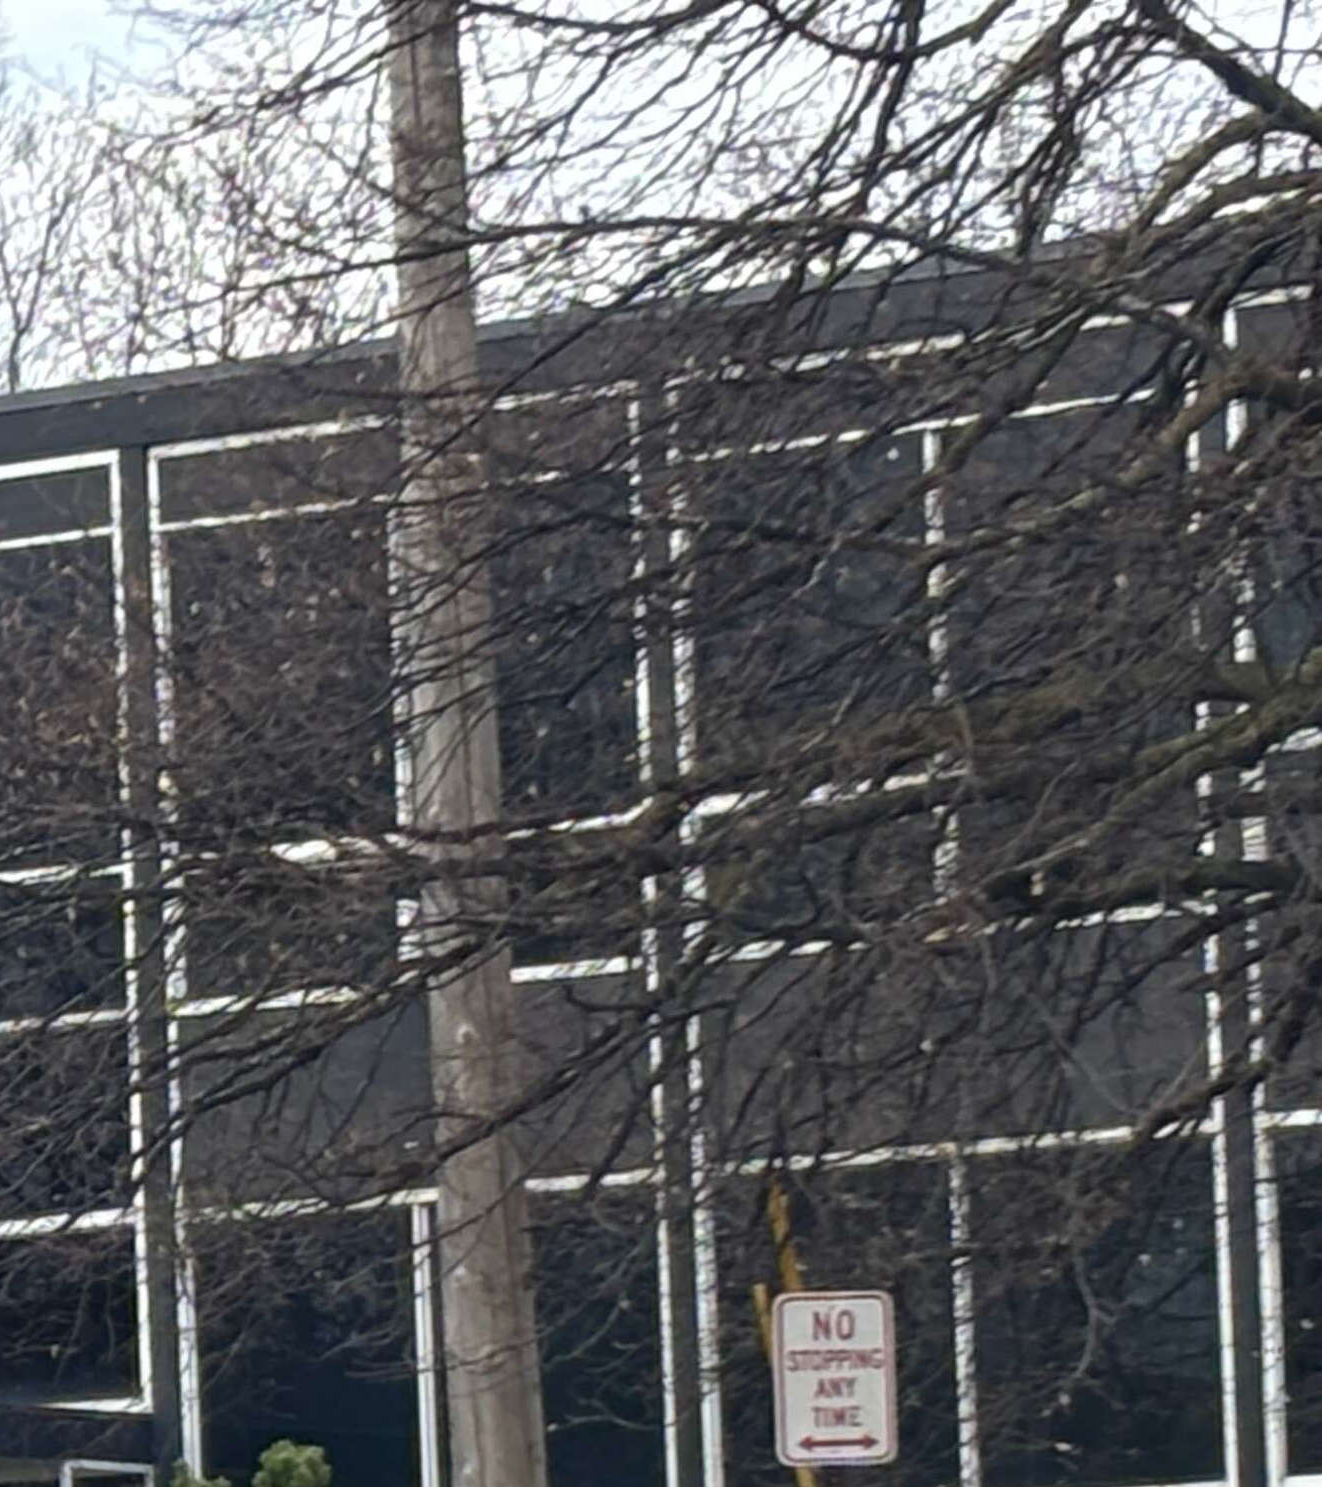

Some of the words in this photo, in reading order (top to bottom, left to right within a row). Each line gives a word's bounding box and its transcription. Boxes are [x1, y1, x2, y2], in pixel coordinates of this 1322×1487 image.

[812, 1310, 856, 1341] NO
[787, 1349, 886, 1372] STOPPING
[814, 1377, 857, 1399] ANY
[811, 1405, 864, 1428] TIME
